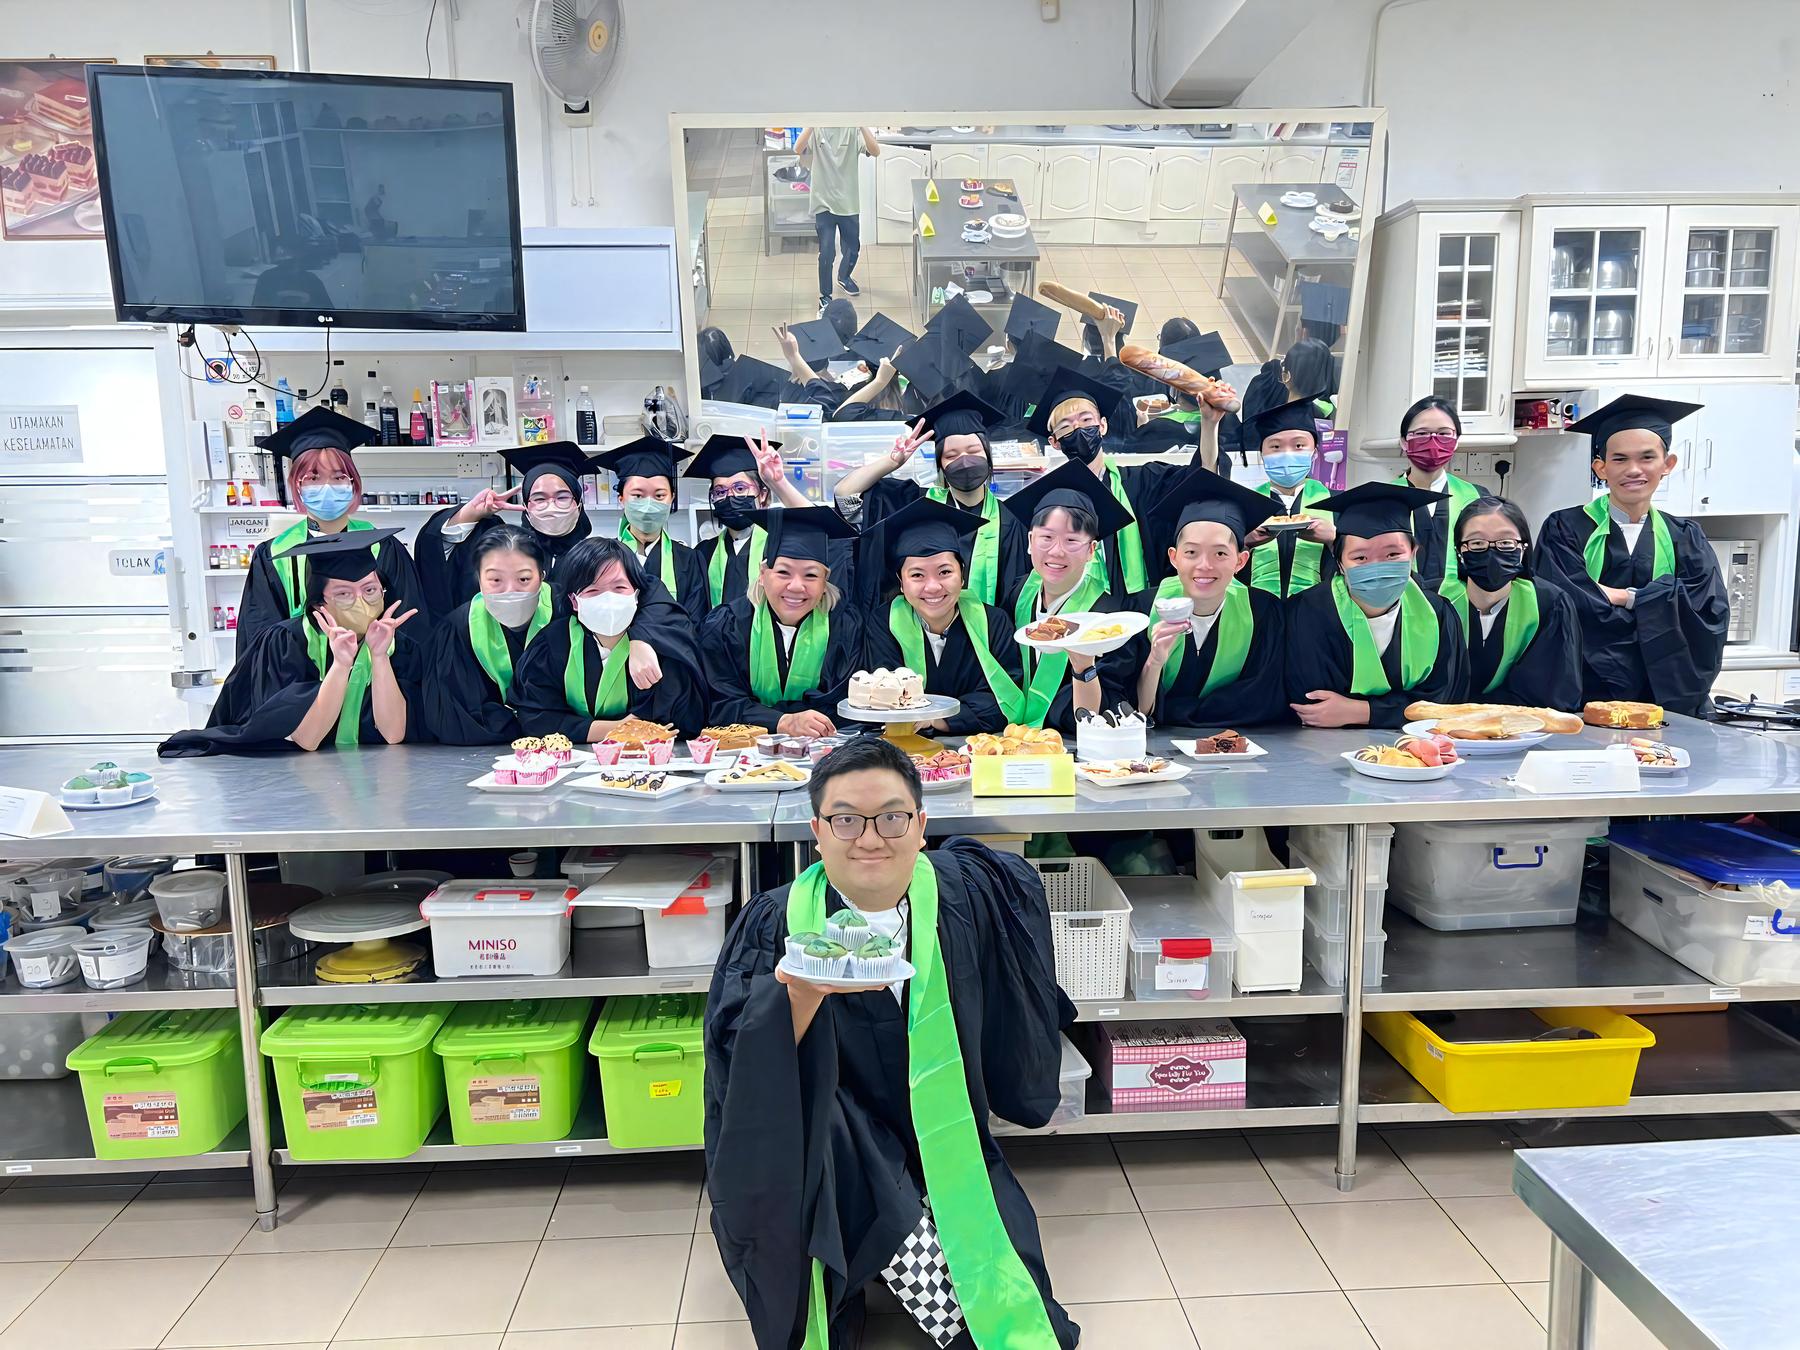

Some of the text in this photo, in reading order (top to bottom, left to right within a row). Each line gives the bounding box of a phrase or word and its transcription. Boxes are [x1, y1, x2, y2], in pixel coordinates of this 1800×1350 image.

[9, 416, 64, 430] UTAMAKAN
[3, 436, 74, 451] KESELAMATAN
[116, 557, 151, 568] TOLAK
[468, 938, 517, 951] MINISO
